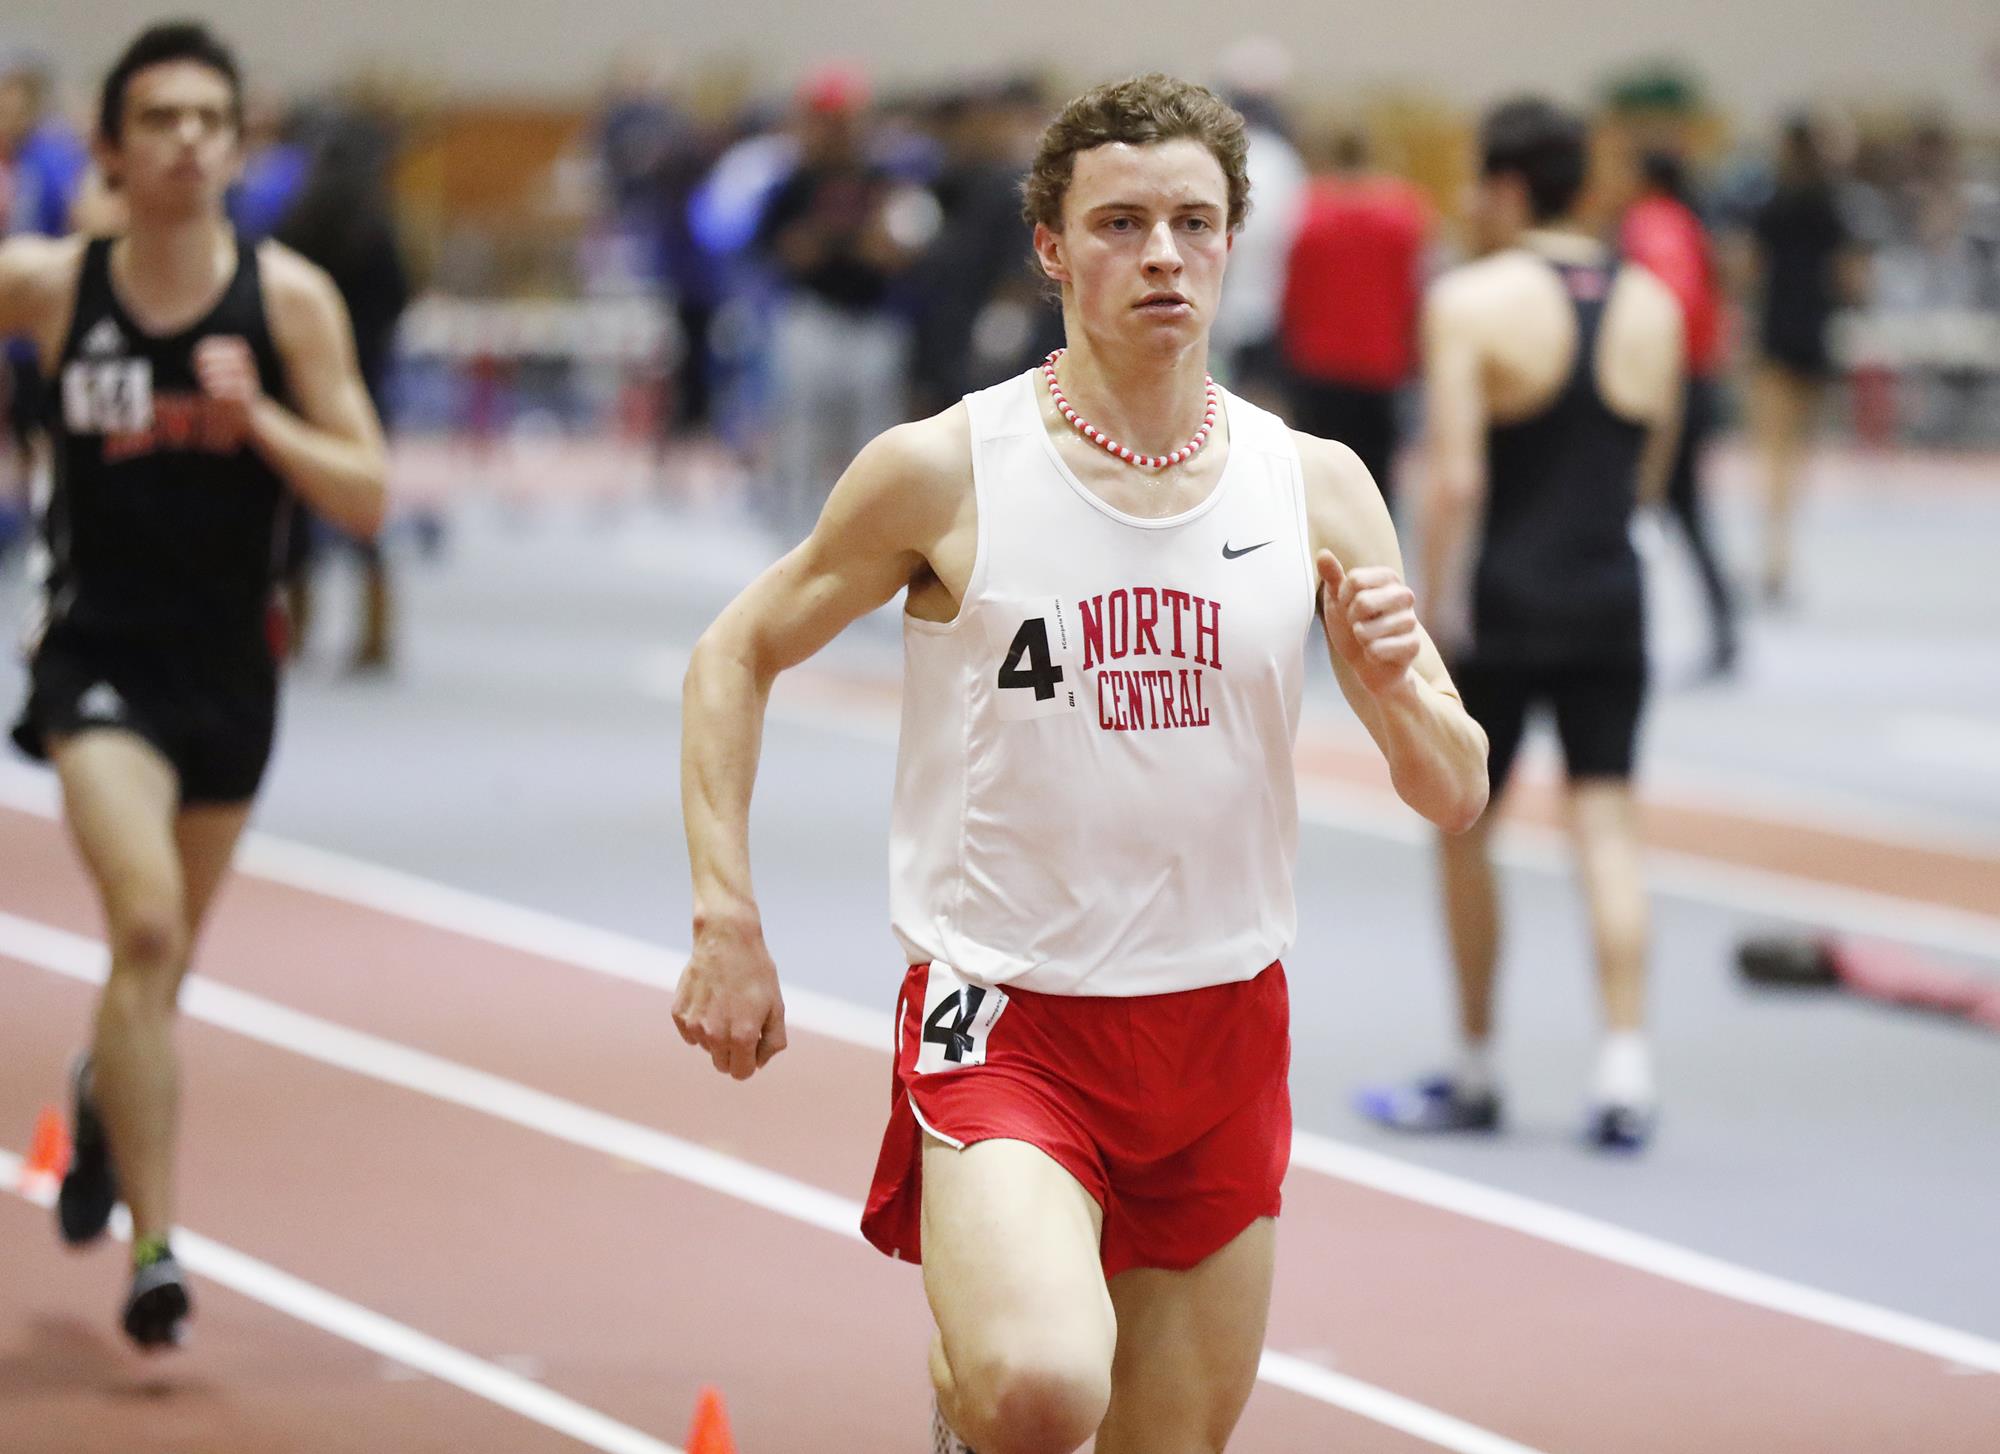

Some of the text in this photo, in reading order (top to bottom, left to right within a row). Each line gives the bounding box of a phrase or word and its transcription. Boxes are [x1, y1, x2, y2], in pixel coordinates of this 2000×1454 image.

[998, 617, 1064, 701] 4
[1079, 587, 1222, 670] NORTH
[1097, 669, 1209, 731] CENTRAL
[923, 984, 987, 1063] 4
